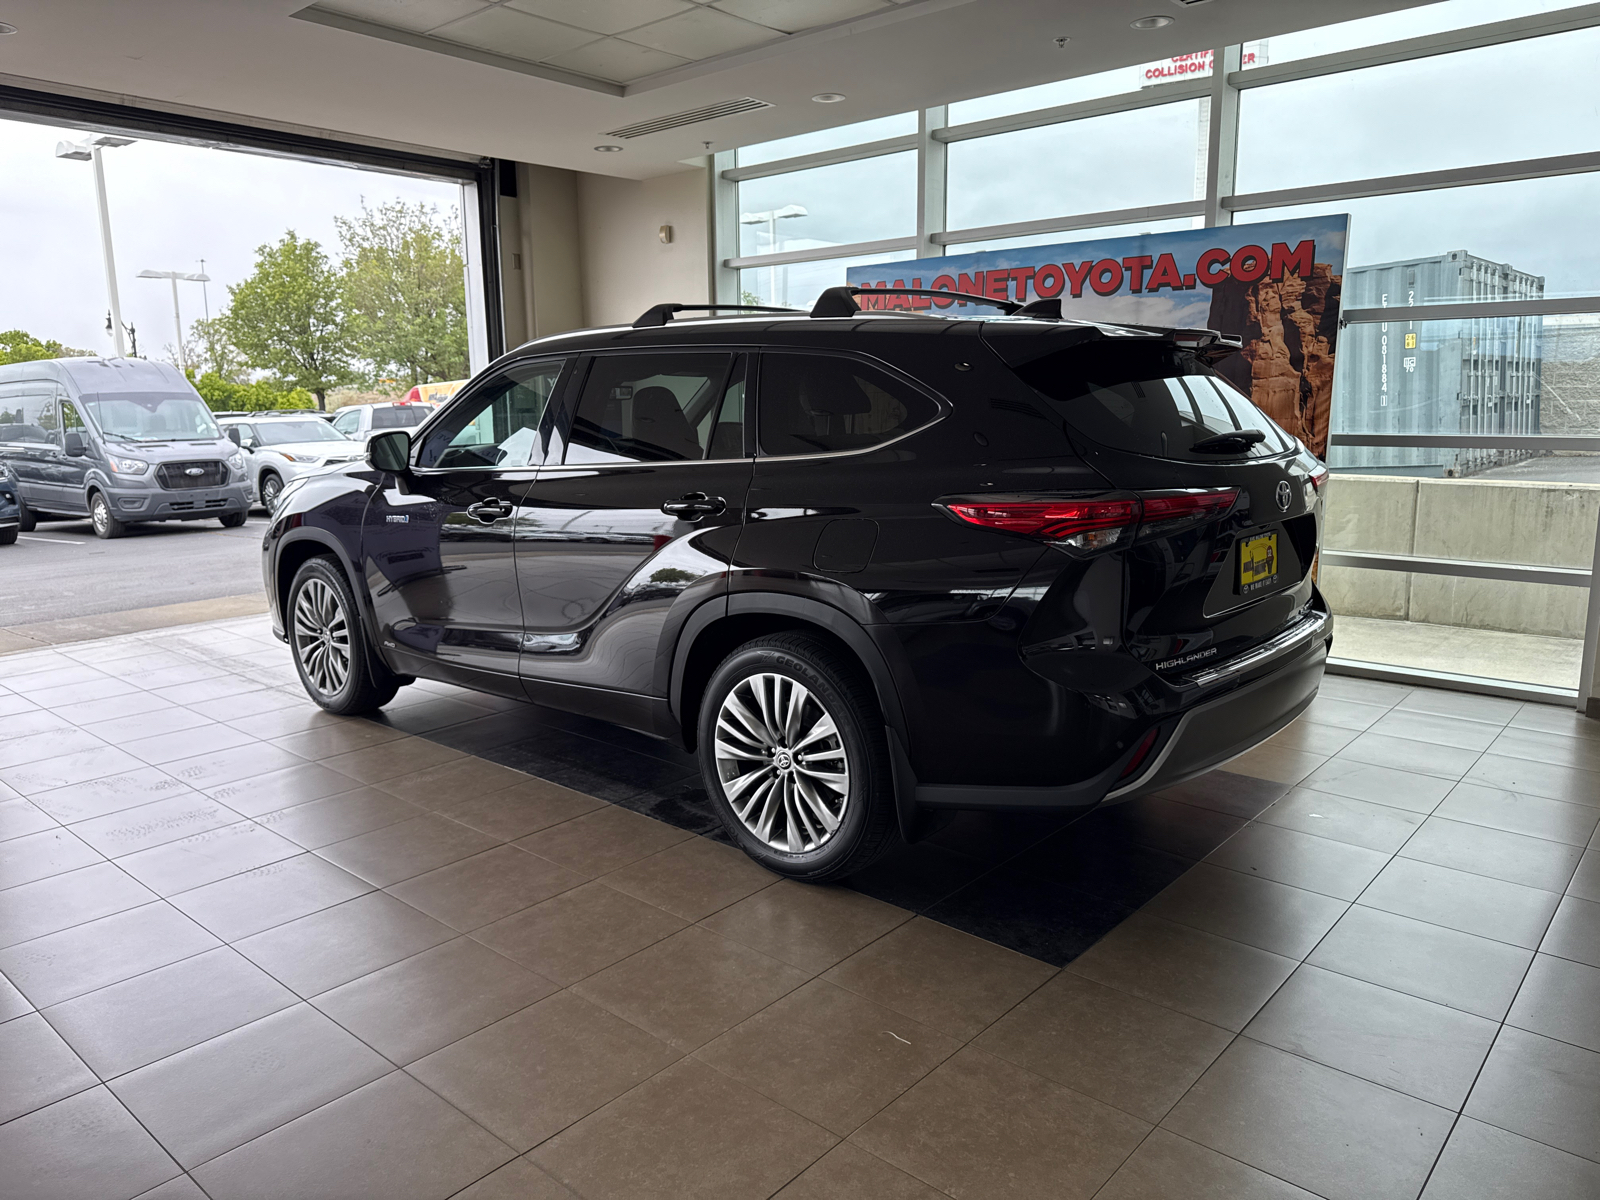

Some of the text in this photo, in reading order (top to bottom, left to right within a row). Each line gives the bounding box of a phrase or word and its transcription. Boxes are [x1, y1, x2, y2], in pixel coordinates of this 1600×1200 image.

[1145, 61, 1205, 79] COLLISION
[861, 239, 1316, 311] MALONETOYOTA.COM
[386, 515, 405, 523] HYBRID
[1156, 647, 1217, 670] HIGHLANDER
